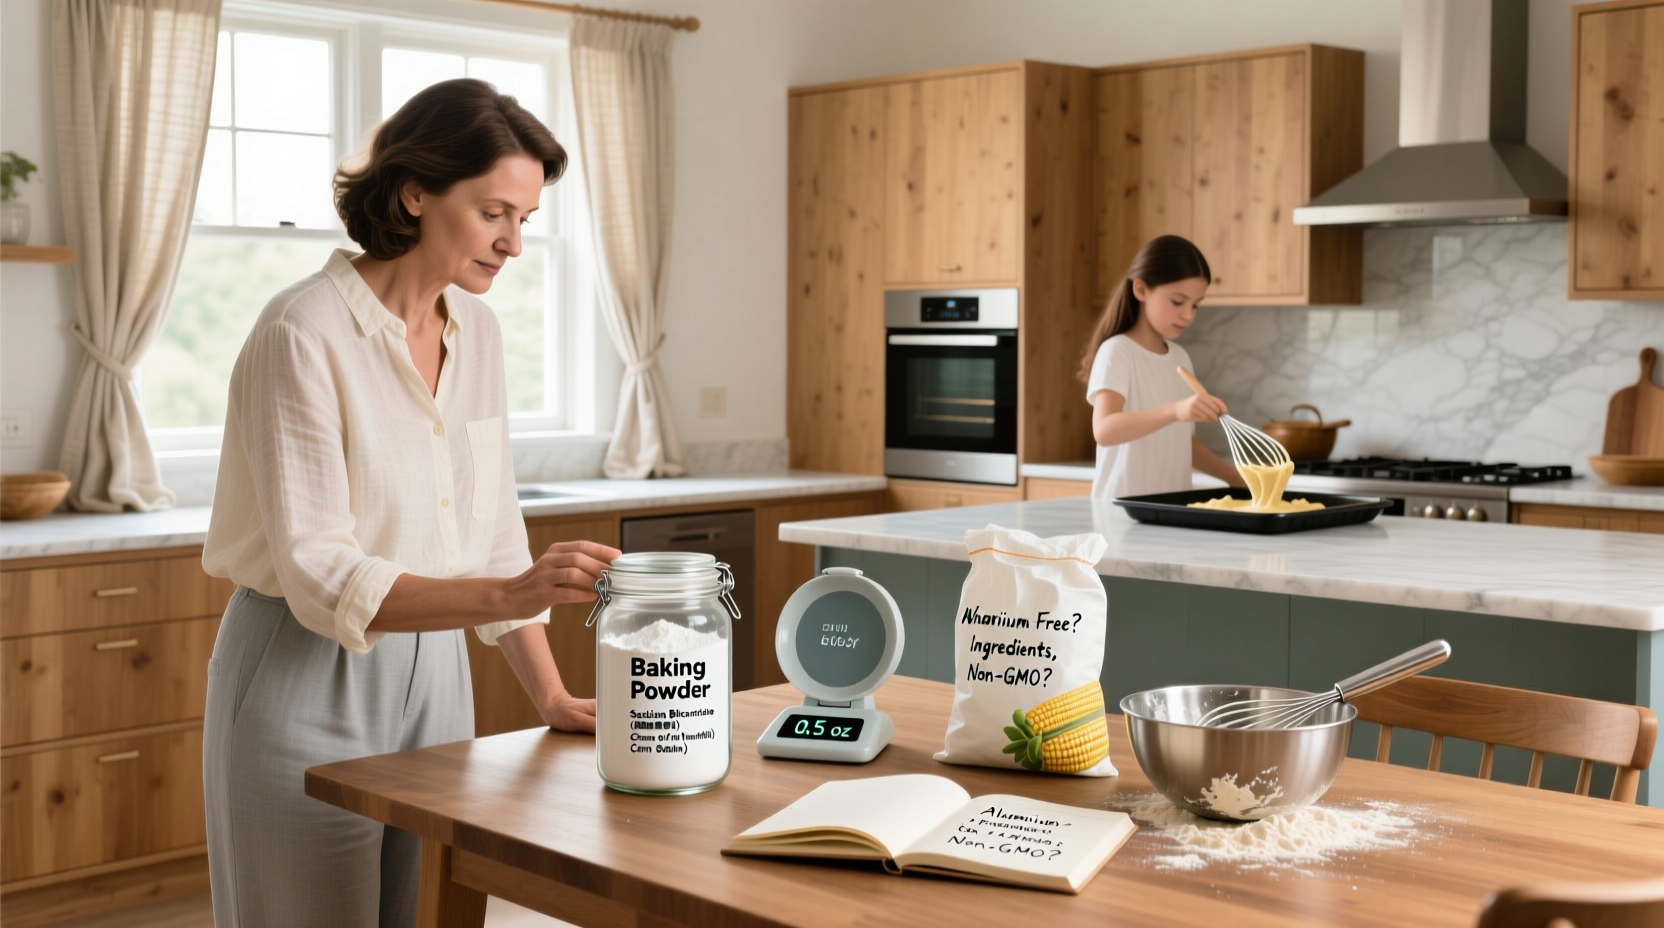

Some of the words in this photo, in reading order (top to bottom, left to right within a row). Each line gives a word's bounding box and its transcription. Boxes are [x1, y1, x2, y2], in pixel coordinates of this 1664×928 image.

[1036, 611, 1082, 634] Free?
[970, 634, 1057, 662] Ingredients,
[631, 657, 706, 681] Baking
[967, 662, 1053, 688] Non-GMO?
[631, 679, 712, 700] Powder
[794, 719, 827, 736] 0.5
[830, 725, 853, 738] oz
